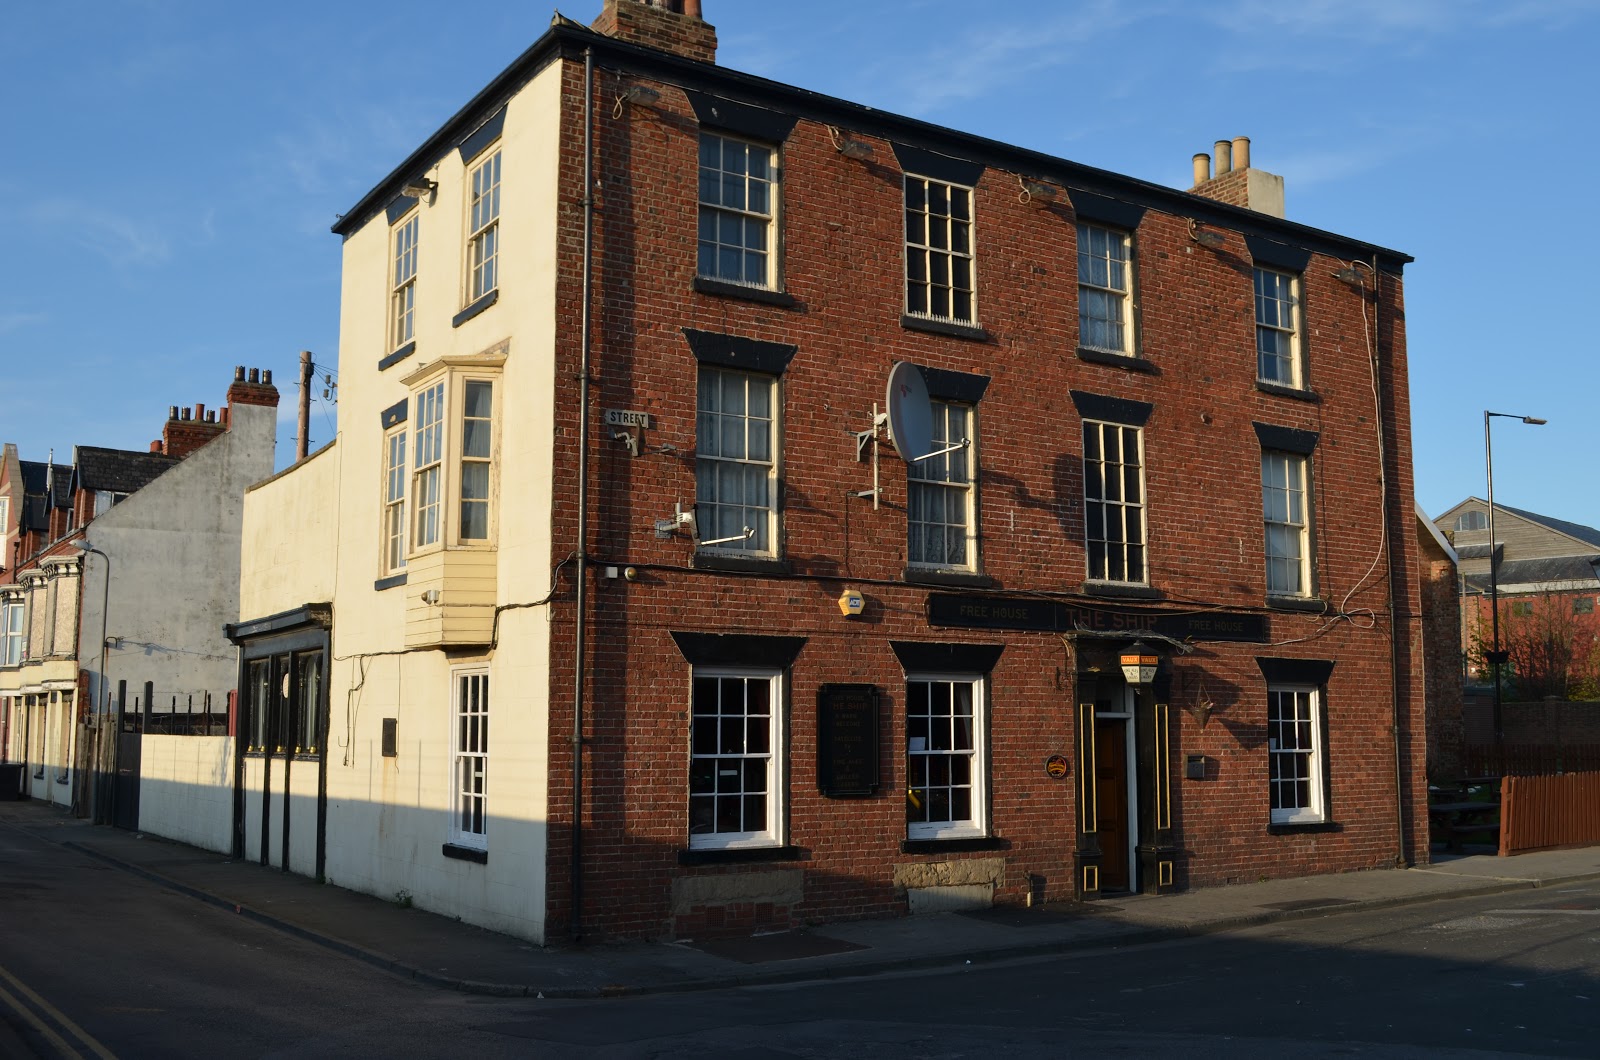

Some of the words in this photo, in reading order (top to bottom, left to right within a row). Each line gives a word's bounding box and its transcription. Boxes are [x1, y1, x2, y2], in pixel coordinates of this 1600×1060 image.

[610, 411, 646, 424] STREET
[960, 605, 988, 618] FREE
[993, 607, 1029, 620] HOUSE
[1065, 608, 1105, 628] THE
[1112, 613, 1158, 631] SHIP
[1188, 620, 1211, 631] FREE
[1215, 621, 1244, 632] HOUSE
